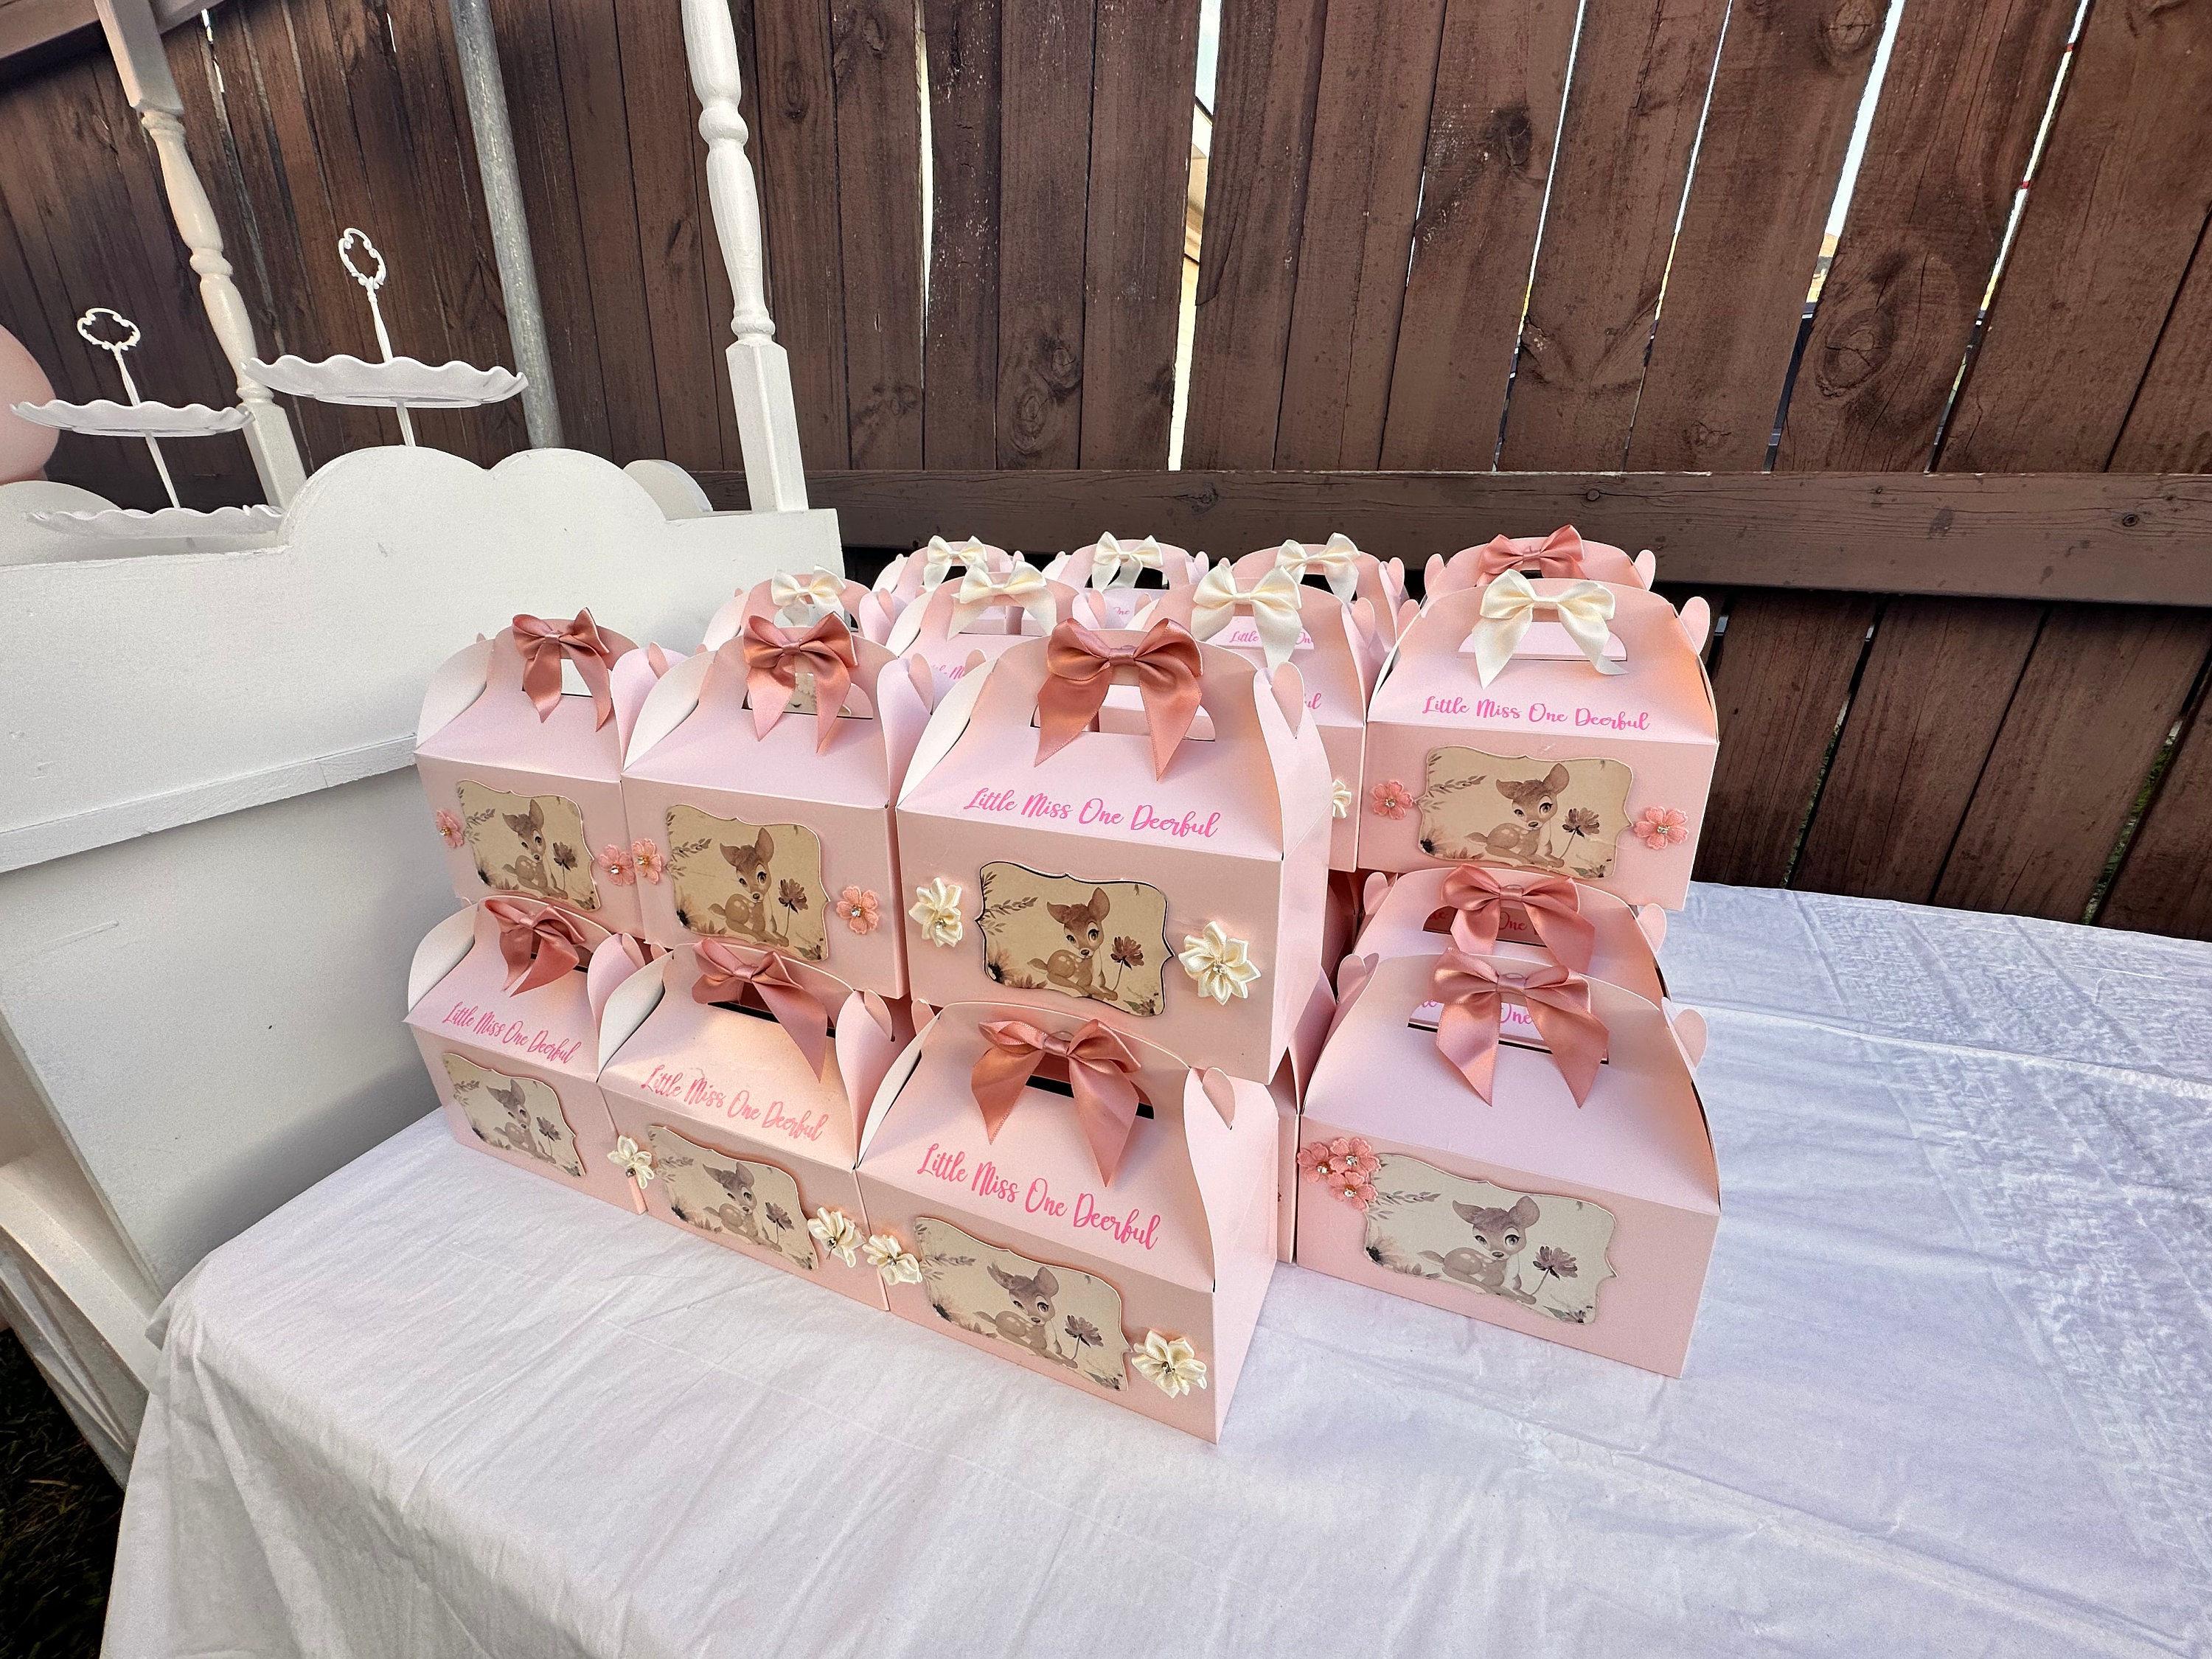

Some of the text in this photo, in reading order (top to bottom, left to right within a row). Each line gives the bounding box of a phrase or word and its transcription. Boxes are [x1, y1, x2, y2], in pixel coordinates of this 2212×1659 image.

[1422, 696, 1651, 731] Little Miss One Deerful
[963, 787, 1222, 839] Little Miss One Deerful
[442, 1001, 582, 1064] Little Miss One Deerful
[639, 1063, 829, 1142] Little Miss One Deerful
[916, 1141, 1162, 1251] Little Miss One Deerful
